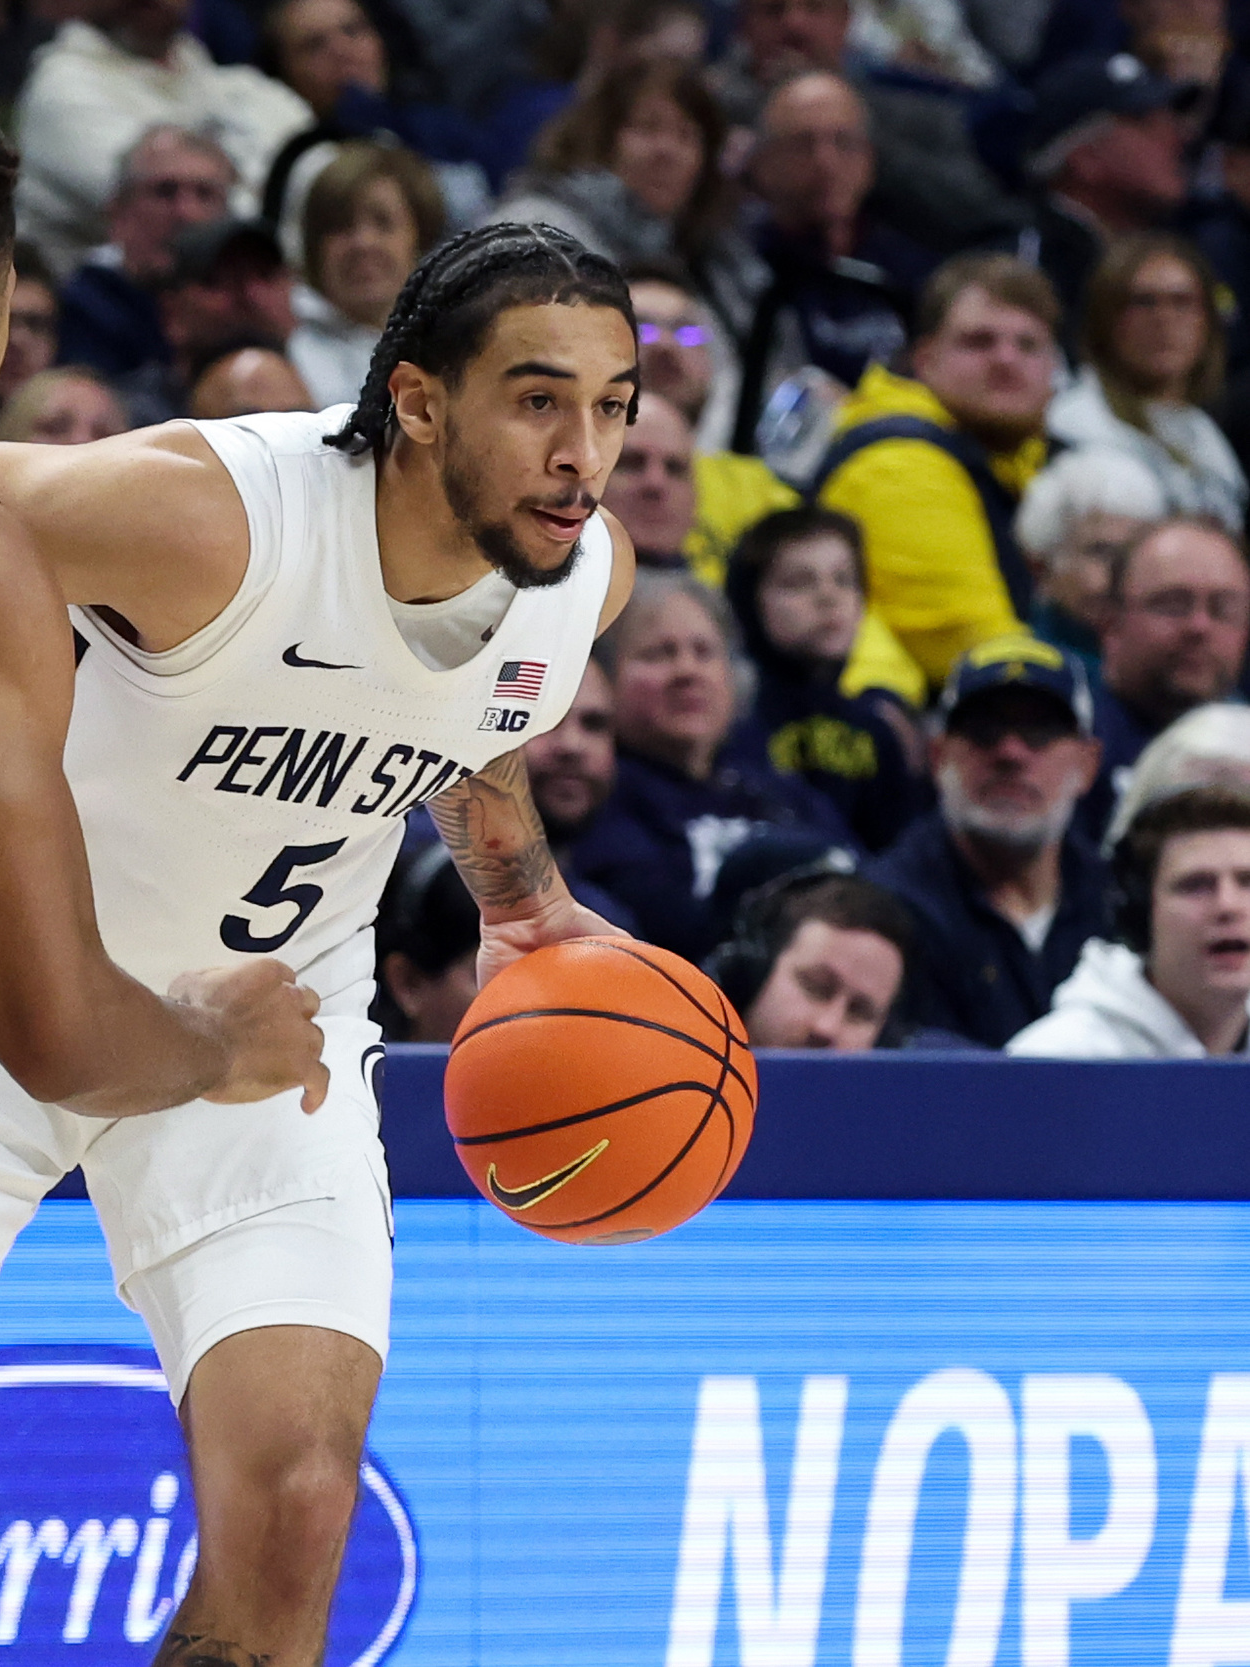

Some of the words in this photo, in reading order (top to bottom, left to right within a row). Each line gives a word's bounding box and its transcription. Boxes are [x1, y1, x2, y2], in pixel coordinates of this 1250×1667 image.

[176, 725, 370, 808] PENN
[351, 743, 475, 818] STA
[219, 836, 350, 954] 5
